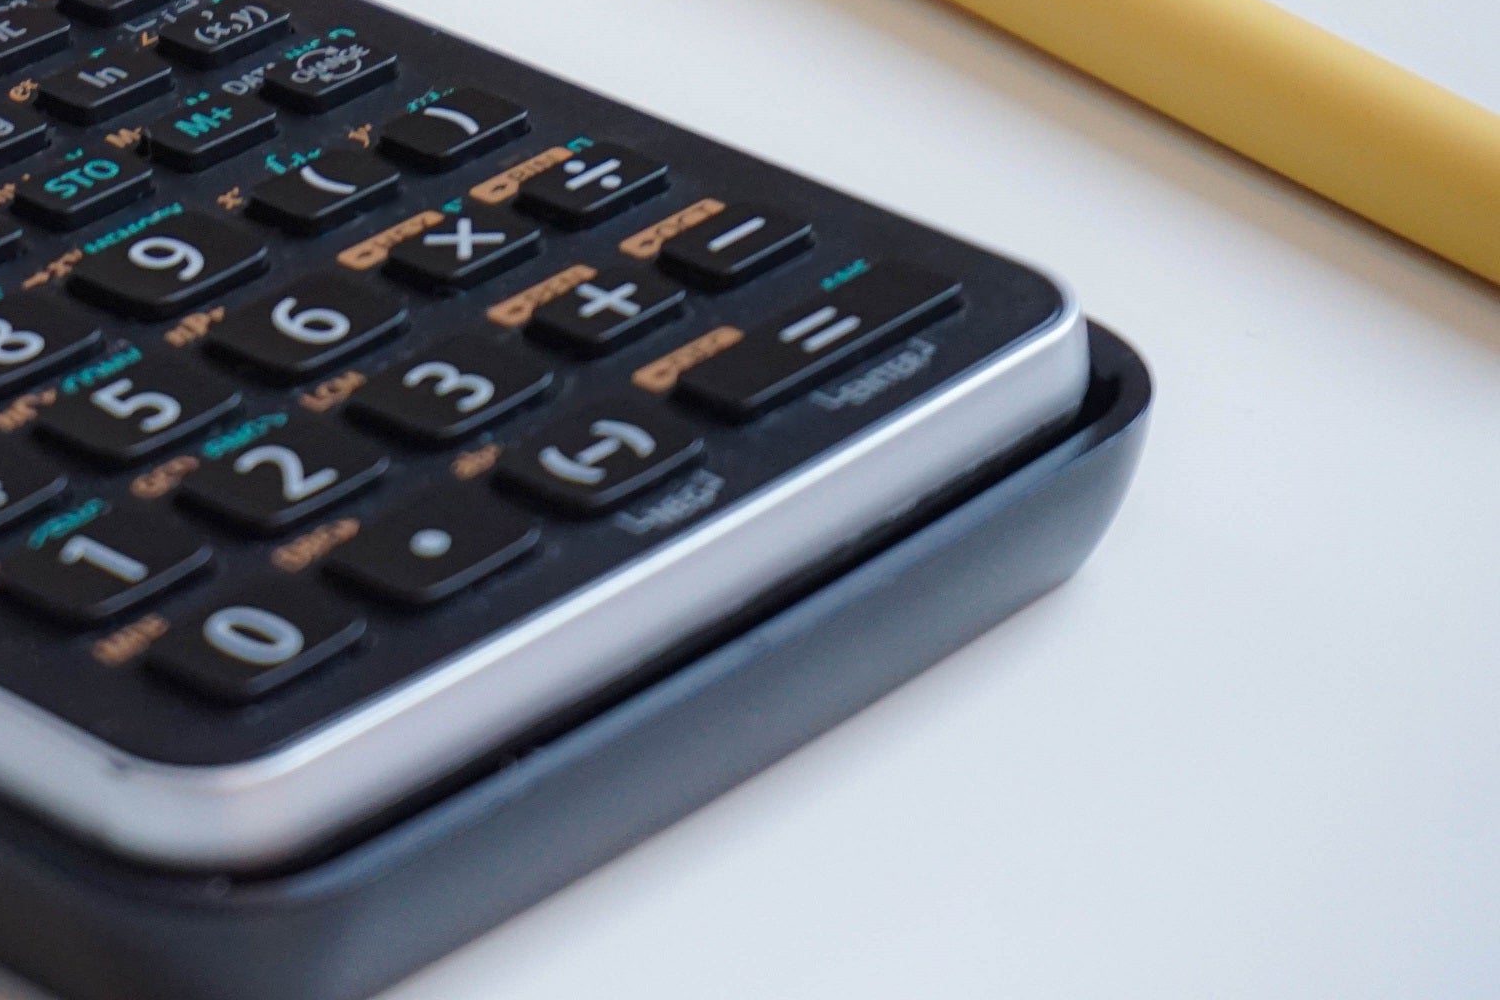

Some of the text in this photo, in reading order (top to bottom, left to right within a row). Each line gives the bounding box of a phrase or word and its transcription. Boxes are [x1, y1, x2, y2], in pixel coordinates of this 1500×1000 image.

[77, 66, 129, 89] ln
[174, 106, 232, 138] M+
[44, 158, 120, 199] STO
[128, 236, 205, 281] 9
[271, 297, 351, 344] 6
[92, 378, 181, 432] 5
[404, 361, 495, 412] 3
[235, 445, 337, 500] 2
[61, 535, 147, 581] 1
[204, 606, 304, 664] 0
